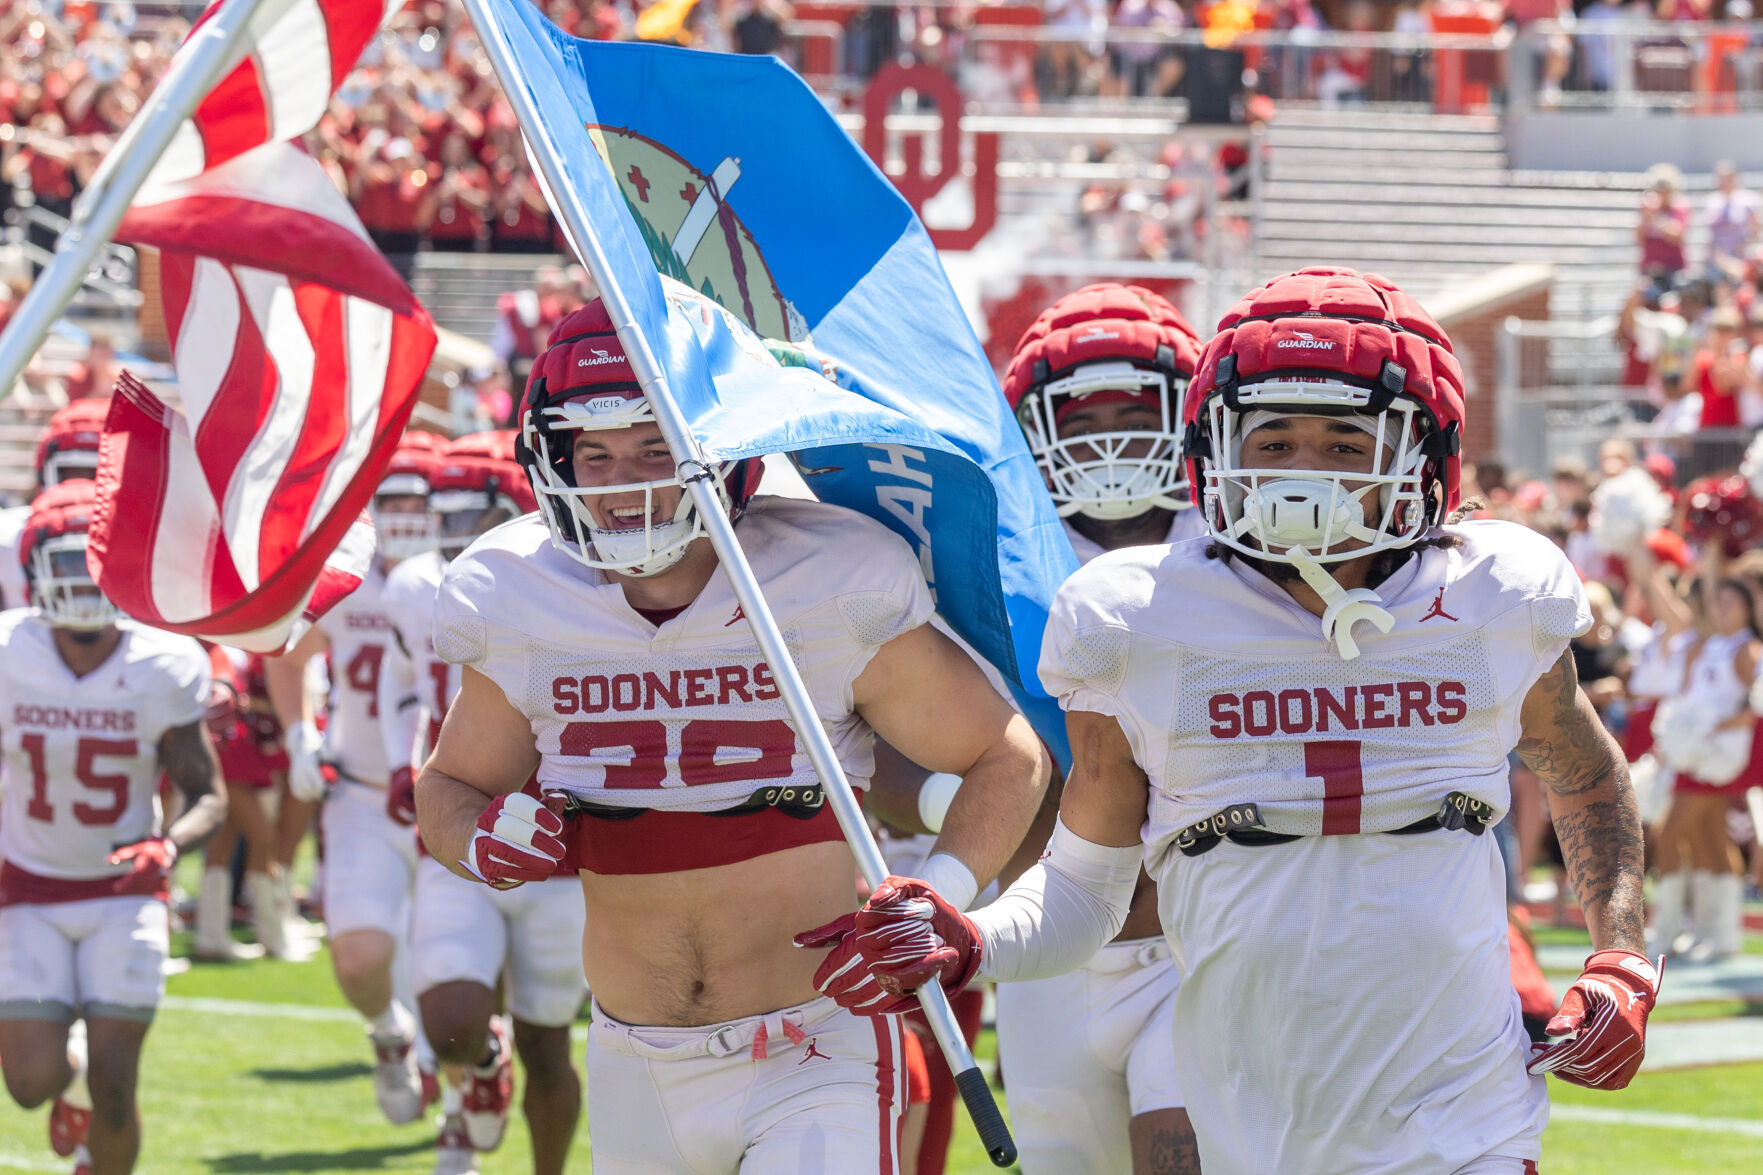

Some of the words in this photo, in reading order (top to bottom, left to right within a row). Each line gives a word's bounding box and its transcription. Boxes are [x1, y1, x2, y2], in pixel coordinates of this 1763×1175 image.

[864, 61, 998, 251] OU
[578, 356, 625, 367] GUARDIAN
[1278, 340, 1333, 350] GUARDIAN
[592, 400, 620, 409] VICIS
[552, 662, 782, 715] SOONERS
[1209, 681, 1468, 739] SOONERS
[13, 704, 137, 732] SOONERS
[21, 732, 139, 826] 15
[1304, 740, 1364, 836] 1
